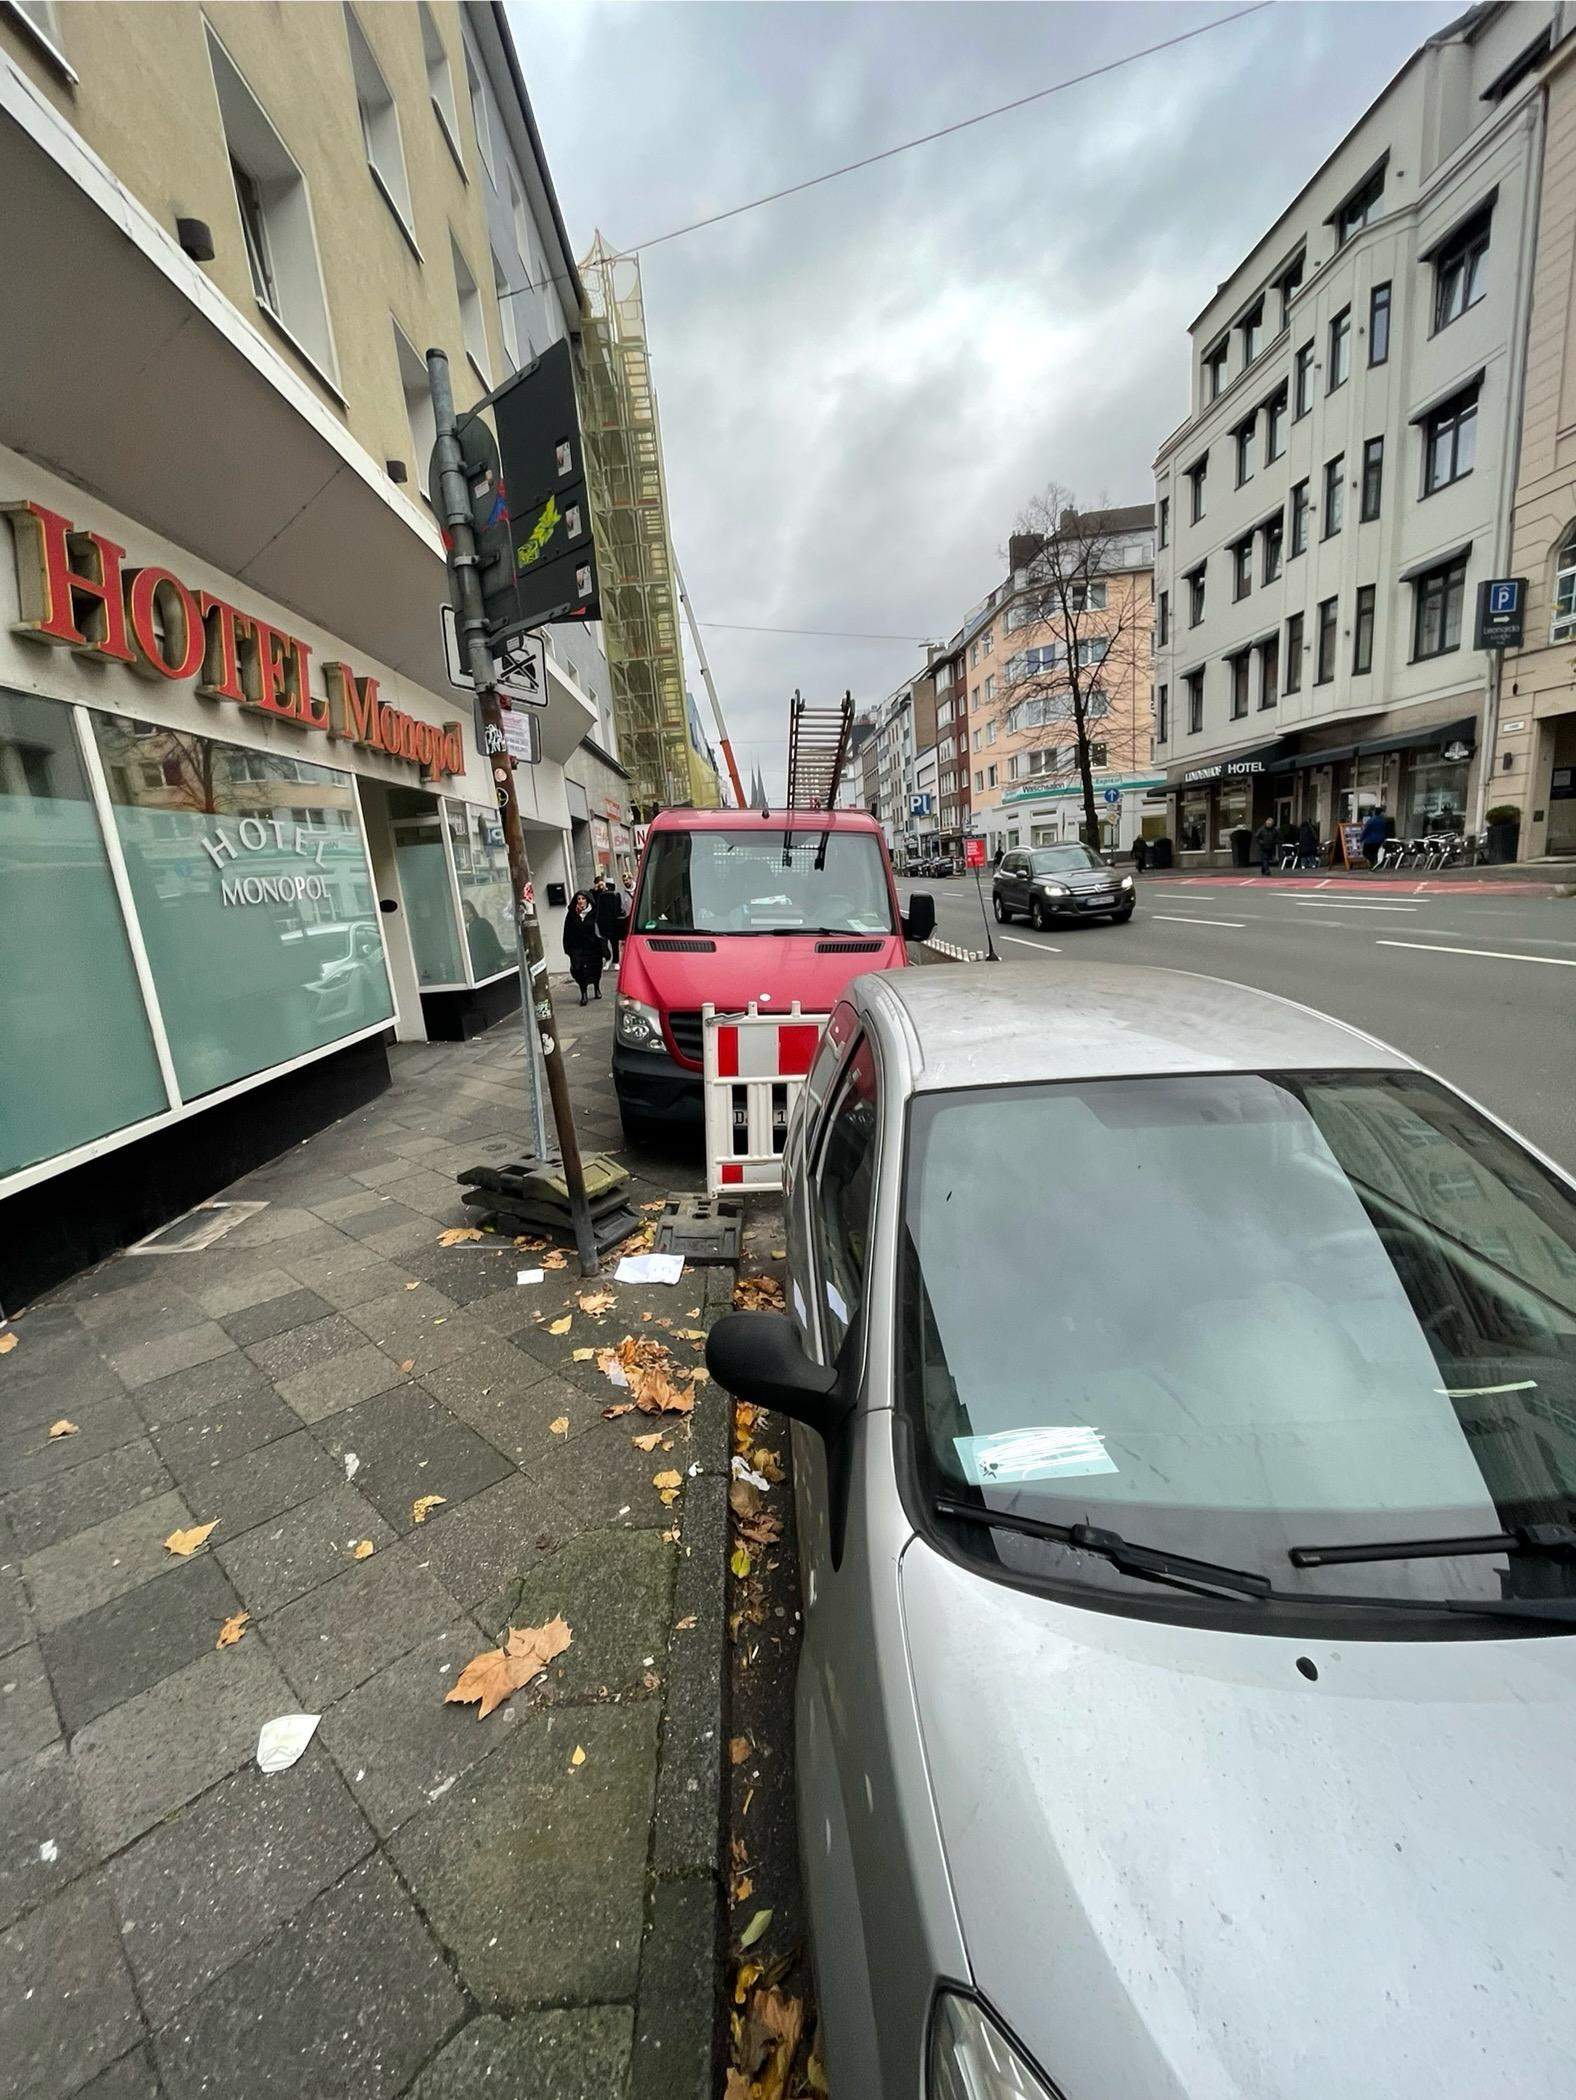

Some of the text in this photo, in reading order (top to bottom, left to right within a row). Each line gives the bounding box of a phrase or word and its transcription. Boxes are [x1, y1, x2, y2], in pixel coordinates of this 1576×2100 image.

[25, 501, 467, 782] HOTEL Monopol
[1228, 761, 1266, 774] HOTEL
[201, 819, 328, 869] HOTEL
[221, 876, 331, 907] MONOPOL
